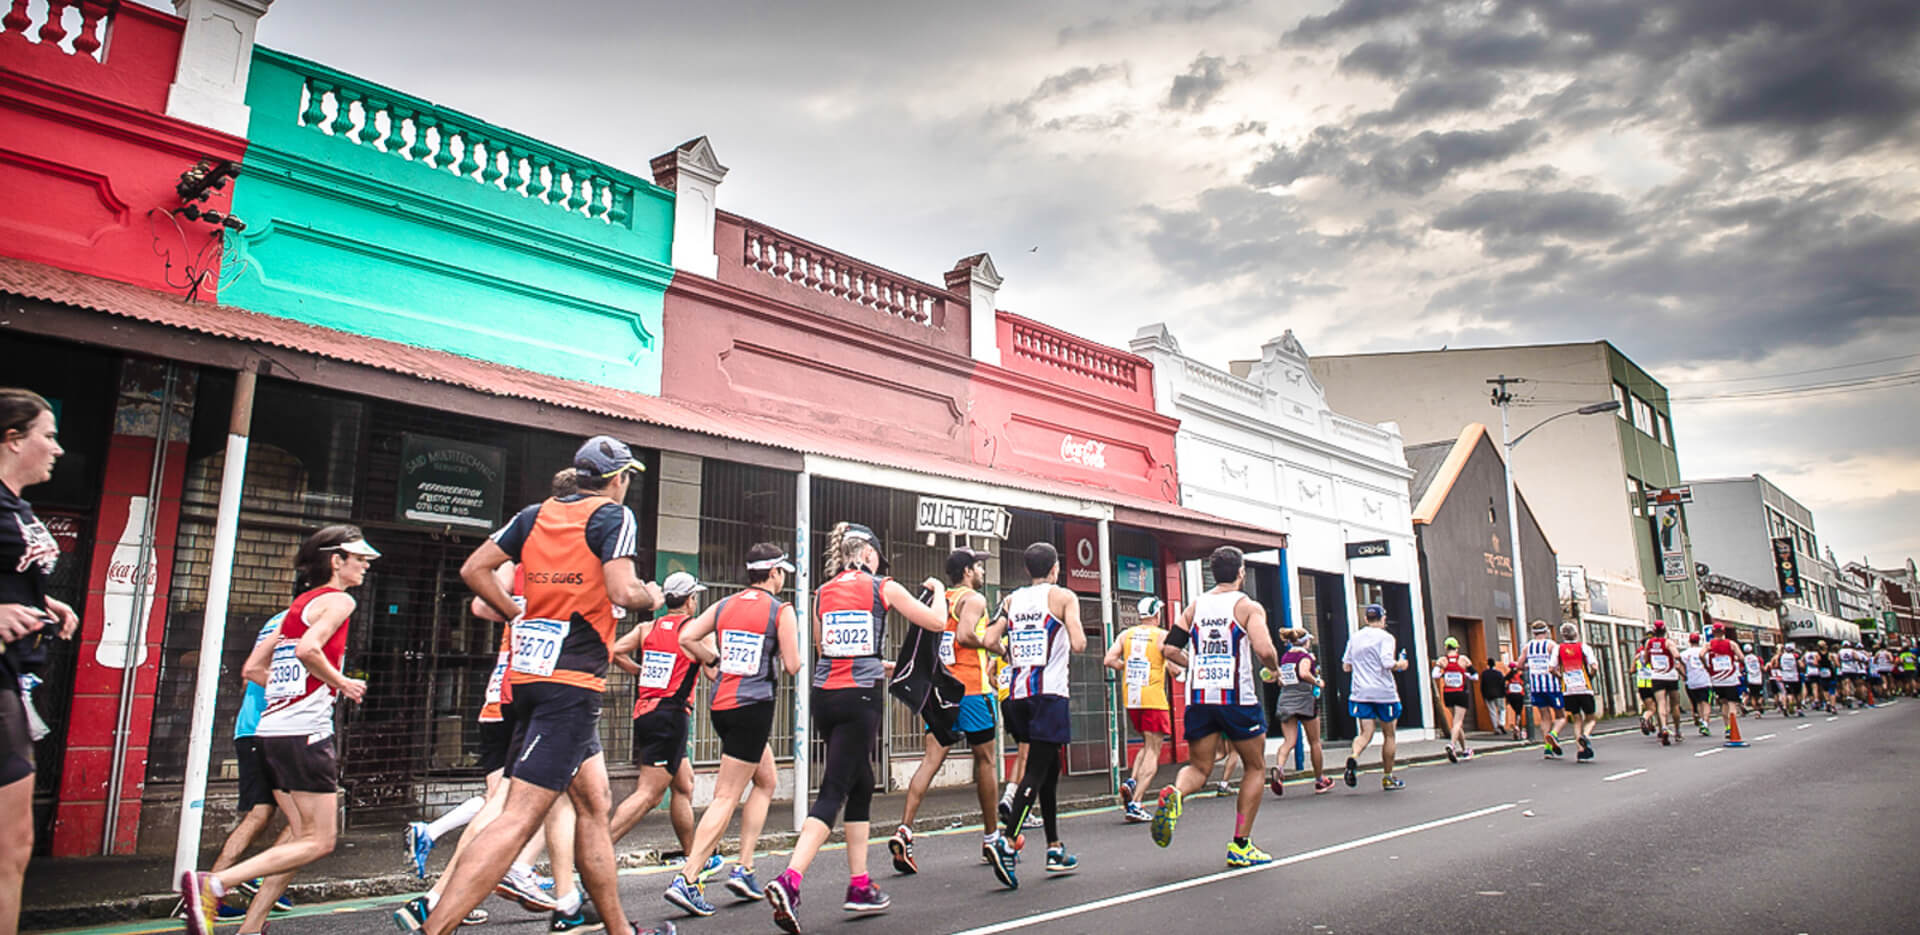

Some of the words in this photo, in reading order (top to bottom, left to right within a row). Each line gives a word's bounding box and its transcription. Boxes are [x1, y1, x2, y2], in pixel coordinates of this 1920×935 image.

[417, 482, 482, 497] REFRIGERATION
[551, 572, 583, 585] GUGS
[1201, 618, 1228, 627] SANDF
[825, 629, 868, 645] C3022
[723, 646, 756, 663] C5721
[1198, 667, 1230, 680] C3834
